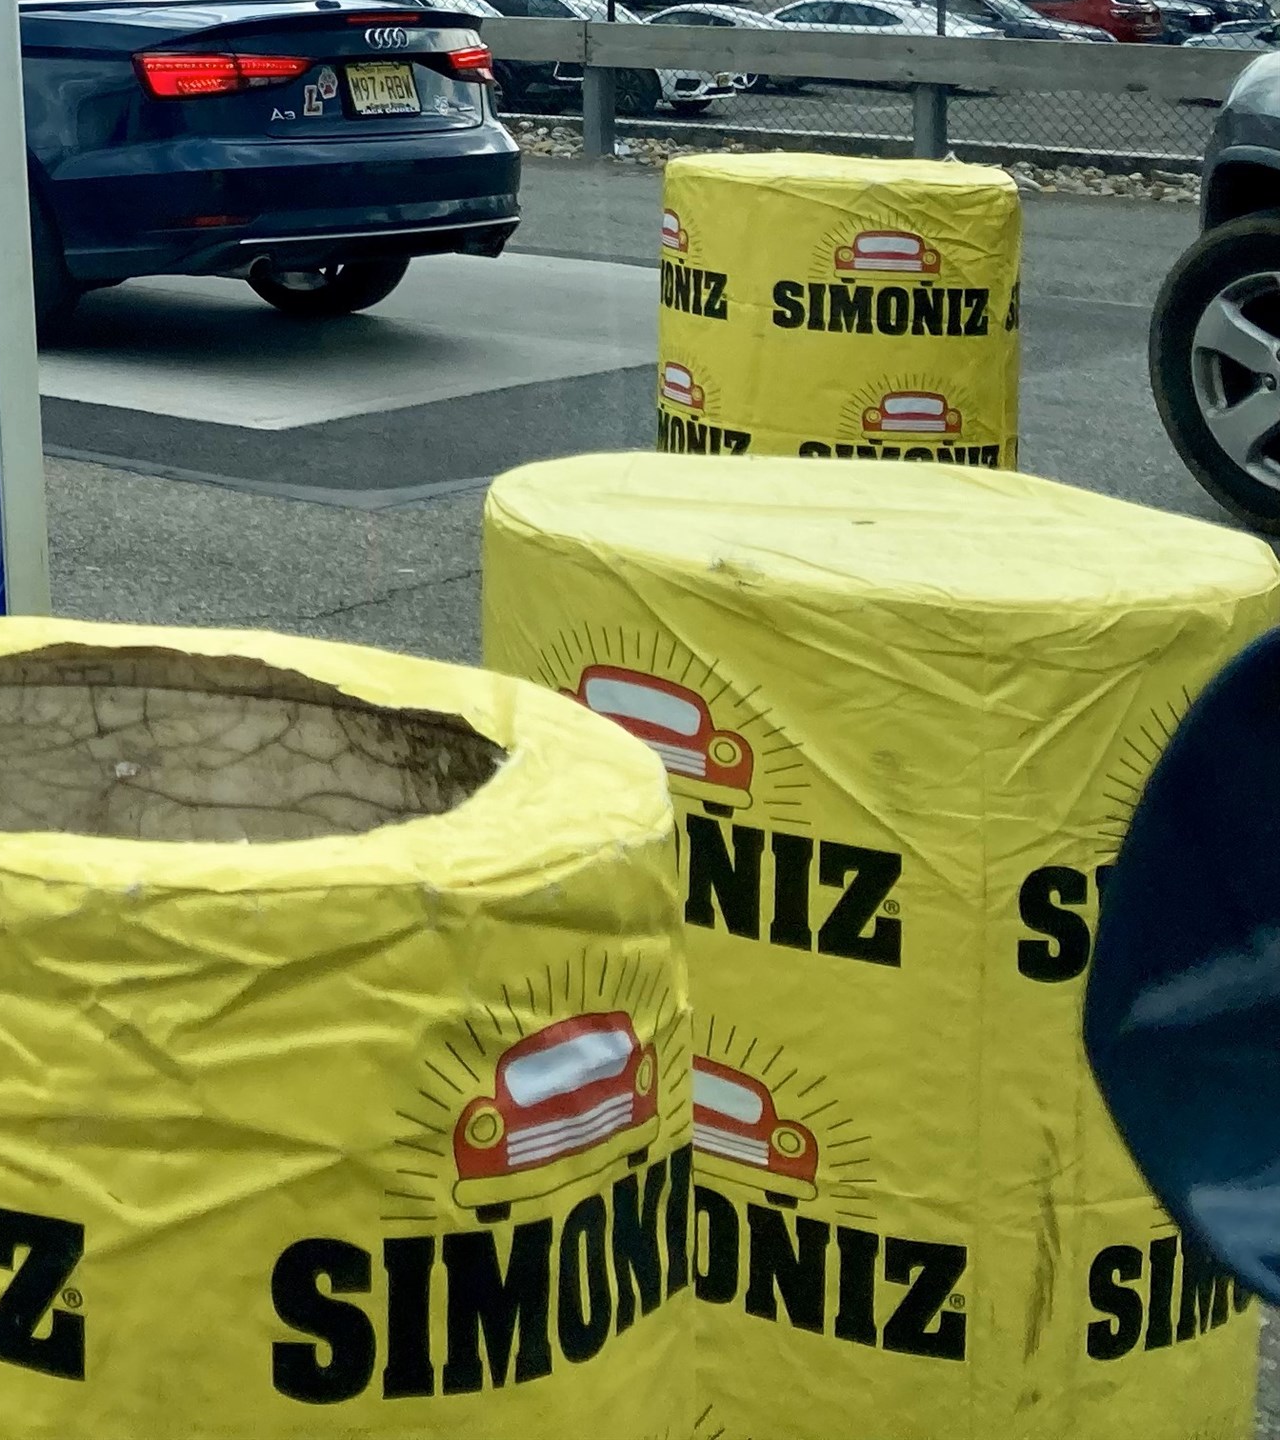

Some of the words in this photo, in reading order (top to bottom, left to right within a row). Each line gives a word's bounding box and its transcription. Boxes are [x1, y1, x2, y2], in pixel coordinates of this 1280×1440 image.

[270, 107, 296, 122] A3
[660, 259, 728, 321] ONIZ
[772, 279, 990, 337] SIMONIZ
[270, 1142, 694, 1406] SIMONI
[694, 1182, 967, 1361] ONIZ
